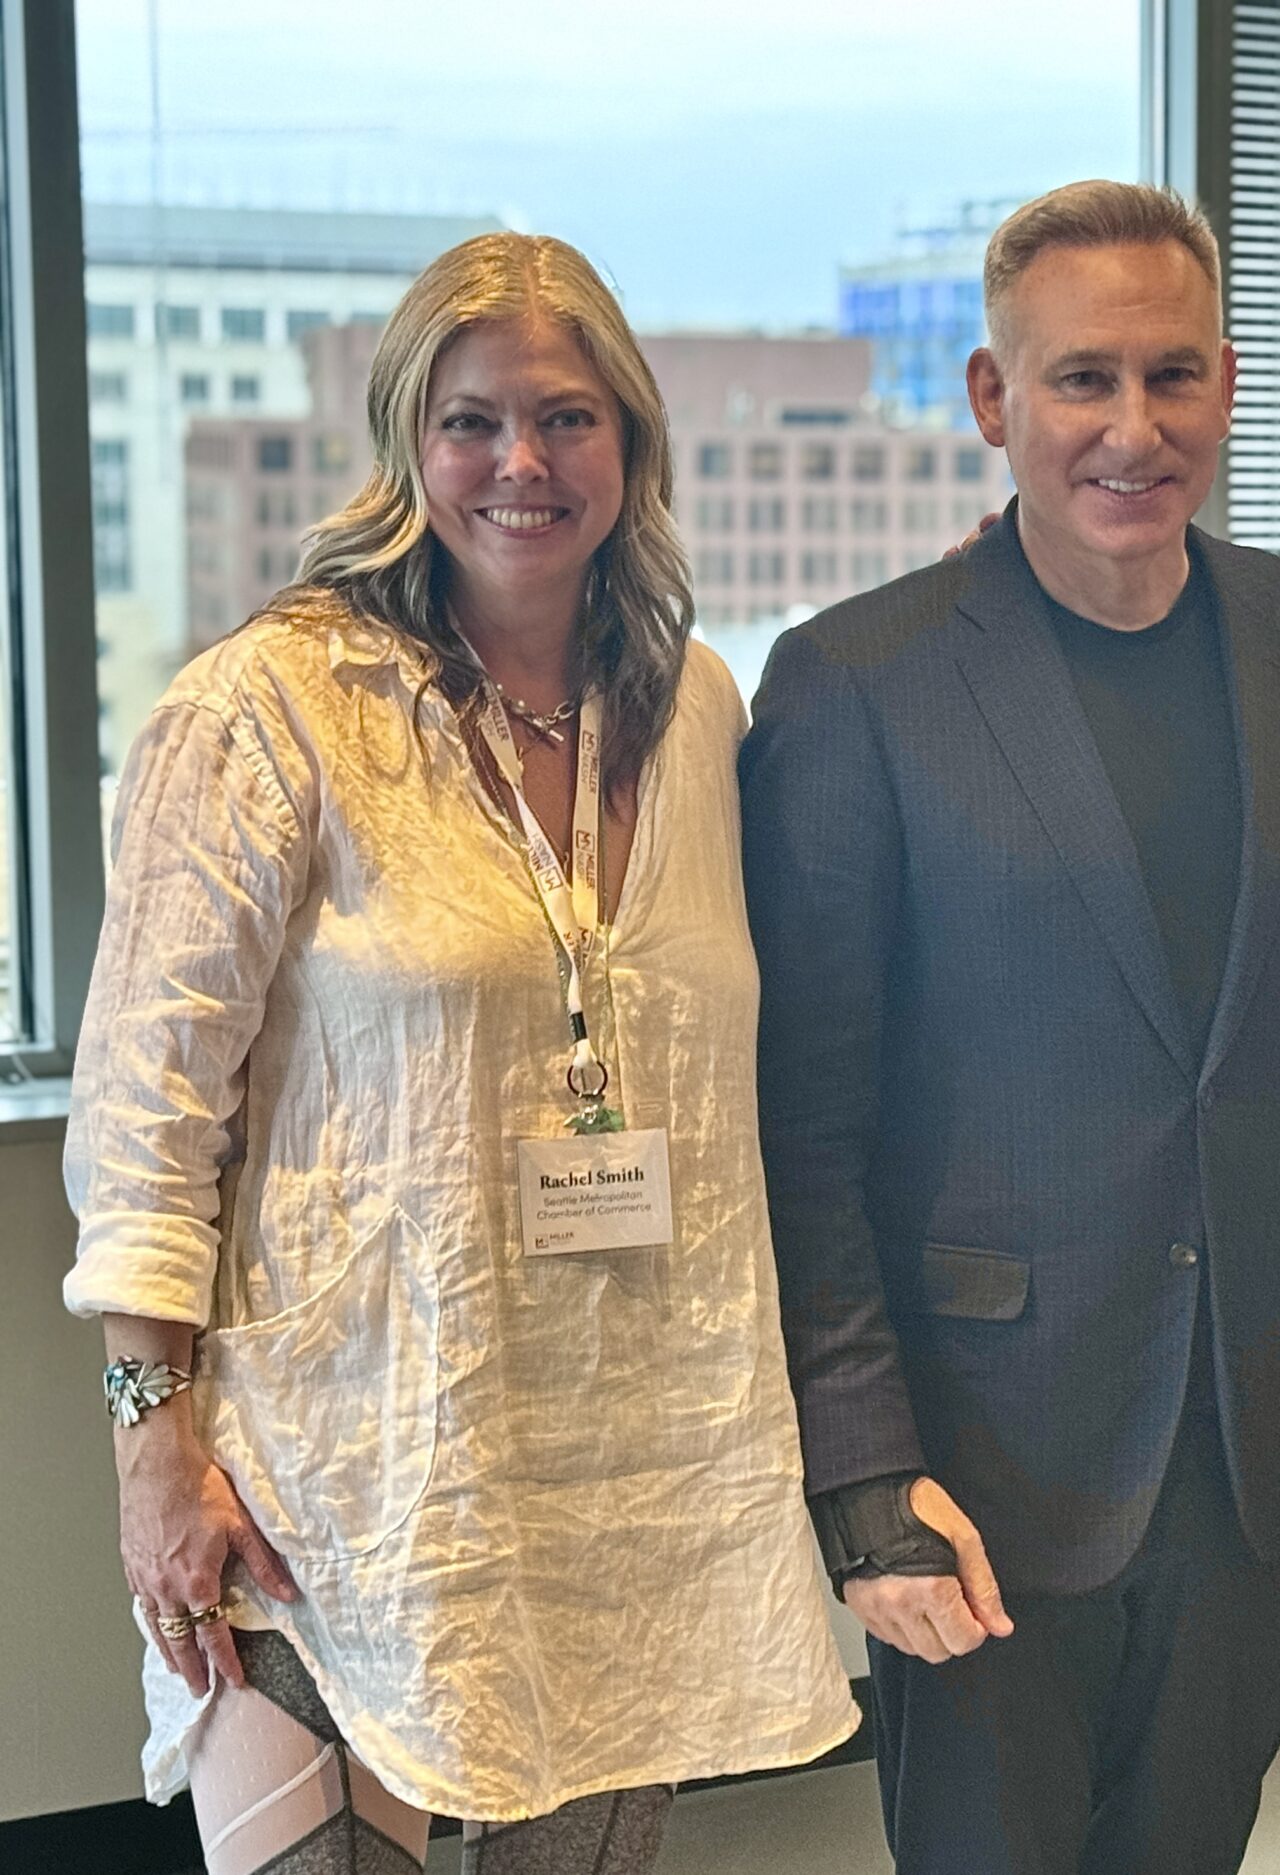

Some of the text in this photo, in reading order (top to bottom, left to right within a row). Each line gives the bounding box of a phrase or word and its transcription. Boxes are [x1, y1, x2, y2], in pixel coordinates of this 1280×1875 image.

[586, 852, 596, 890] MILLER
[540, 1166, 644, 1190] Rachel Smith
[543, 1191, 643, 1207] Seattle Metropolitan
[536, 1203, 651, 1221] Chamber of Commerce
